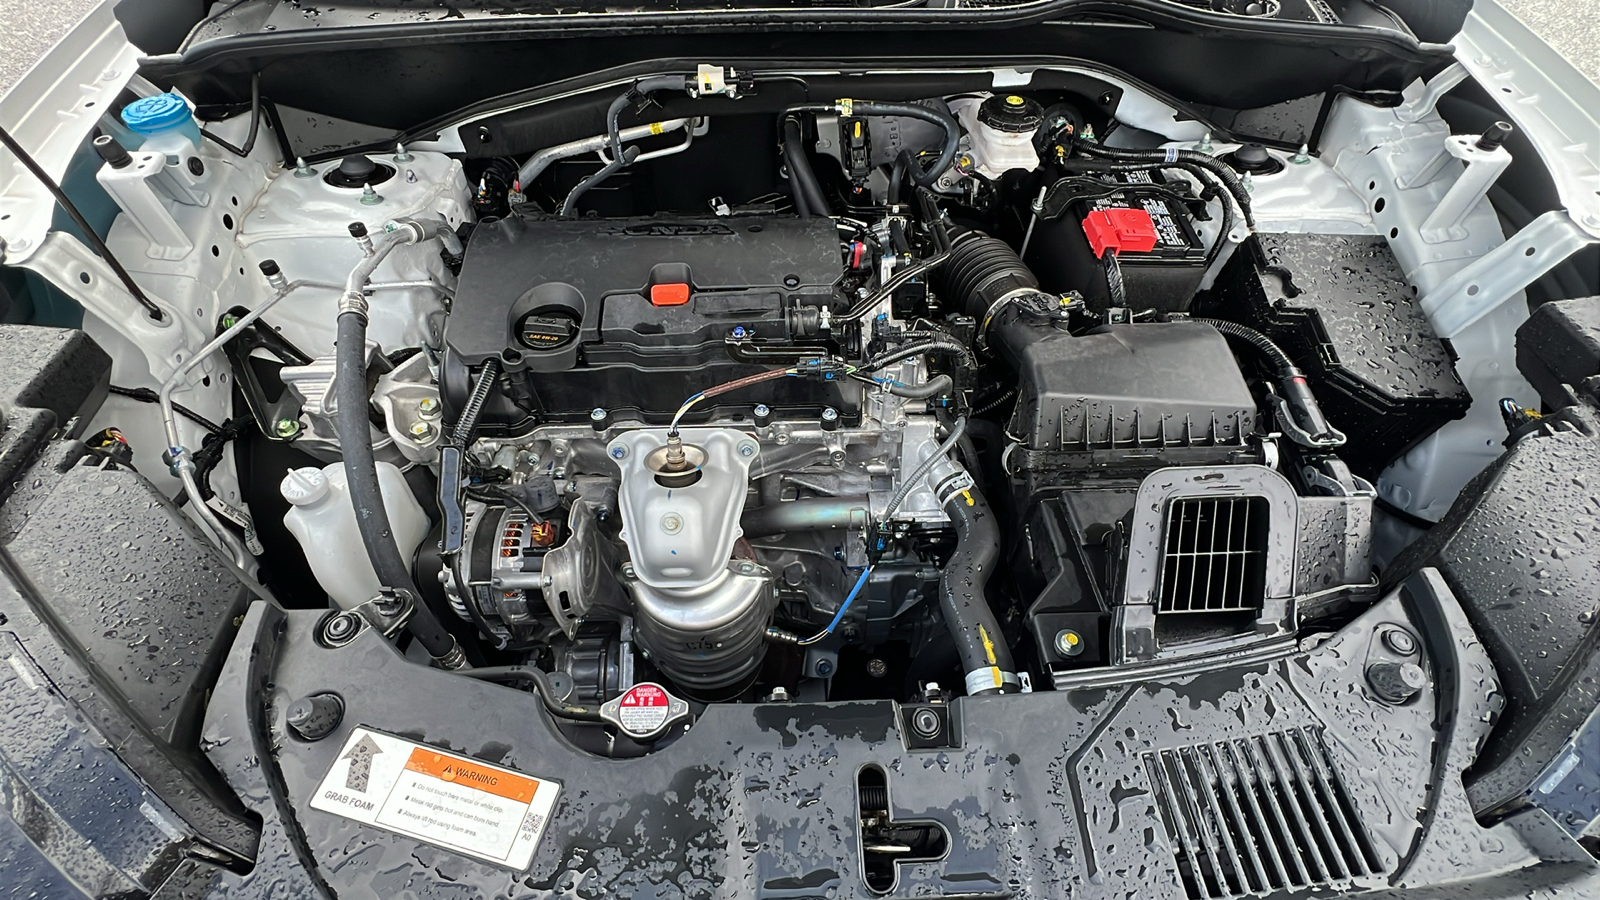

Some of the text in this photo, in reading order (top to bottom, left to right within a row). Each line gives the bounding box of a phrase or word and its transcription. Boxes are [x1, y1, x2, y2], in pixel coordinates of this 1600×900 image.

[455, 767, 498, 786] WARNING
[324, 790, 375, 811] GRAB FOAM
[417, 783, 425, 791] Do
[434, 788, 448, 797] touch
[447, 792, 459, 800] bare
[460, 796, 474, 804] metal
[480, 802, 494, 811] white
[402, 810, 421, 820] Always
[427, 817, 437, 825] rod
[436, 820, 451, 830] using
[451, 824, 464, 832] foam
[410, 796, 424, 806] Metal
[432, 804, 444, 812] gets
[463, 812, 474, 820] can
[473, 815, 485, 824] burn
